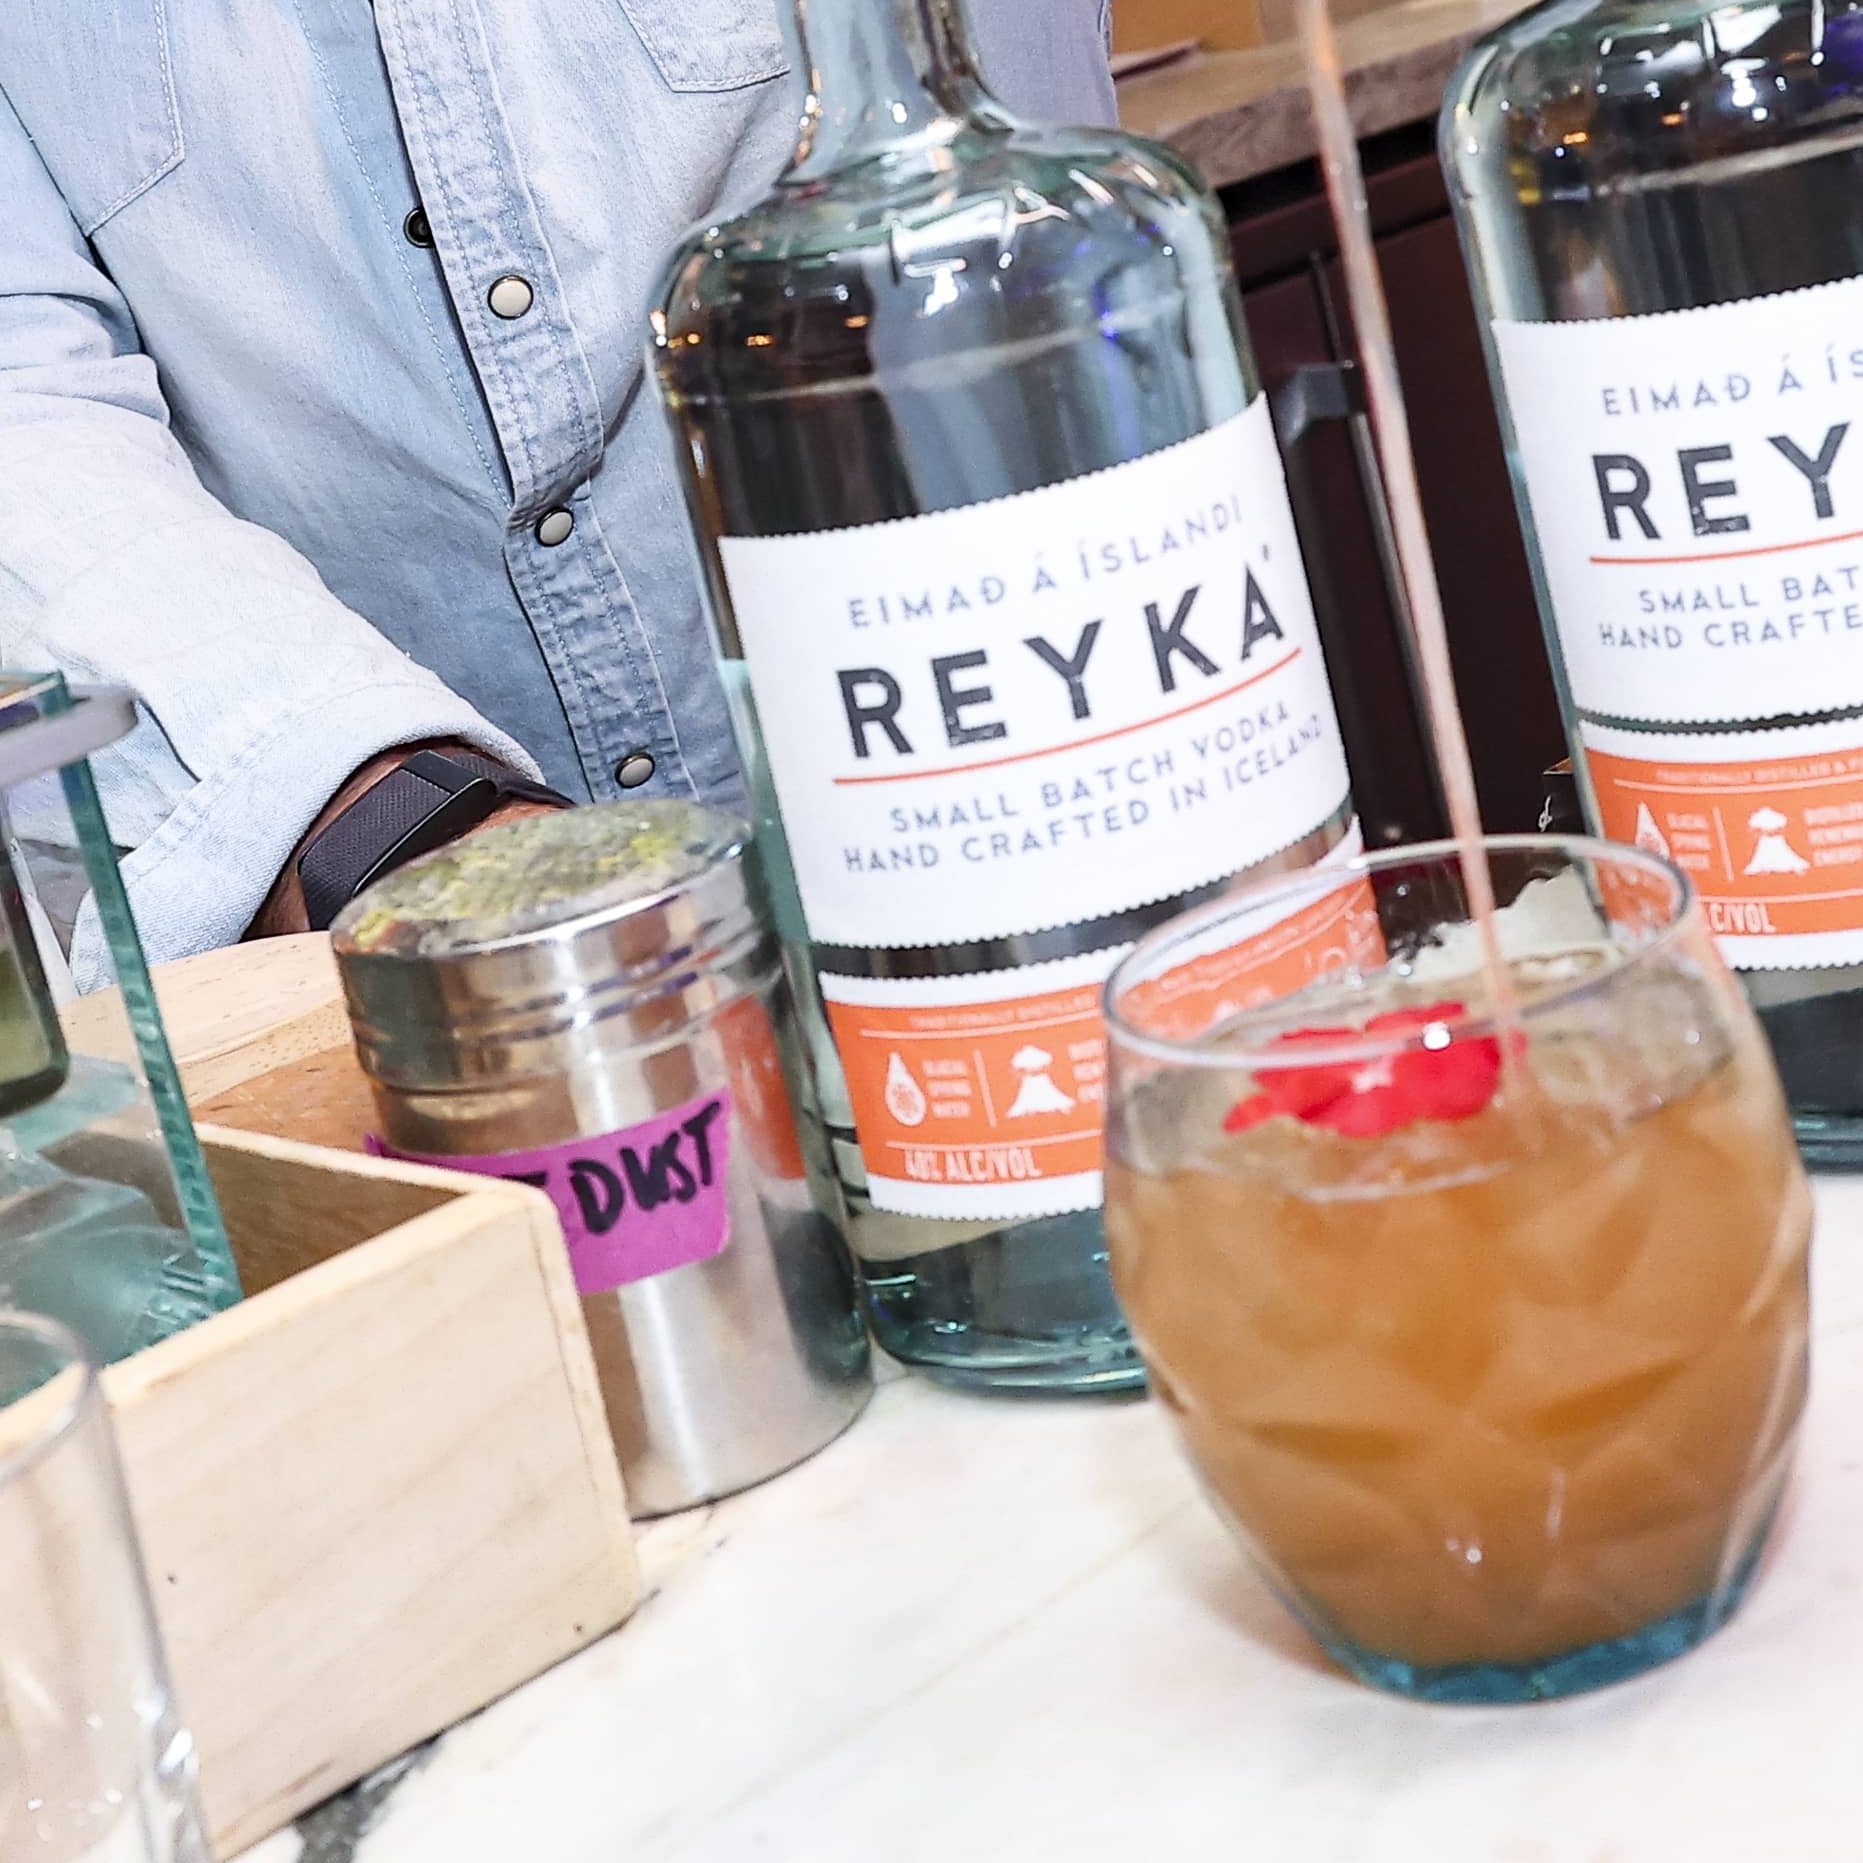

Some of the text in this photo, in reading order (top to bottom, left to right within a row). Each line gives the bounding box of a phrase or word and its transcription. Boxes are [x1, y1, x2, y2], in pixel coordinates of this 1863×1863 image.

[1777, 352, 1804, 395] Á
[1031, 554, 1058, 595] Á
[1078, 493, 1244, 581] ÍSLANDI
[1599, 622, 1683, 650] HAND
[1638, 582, 1760, 614] SMALL
[835, 562, 1286, 759] REYKA
[889, 701, 1291, 834] SMALL BATCH VODKA
[842, 841, 941, 874] HAND
[960, 800, 1150, 864] CRAFTED
[1170, 780, 1208, 812] IN
[567, 1100, 722, 1236] DUST
[945, 1147, 1043, 1181] ALC/VOL
